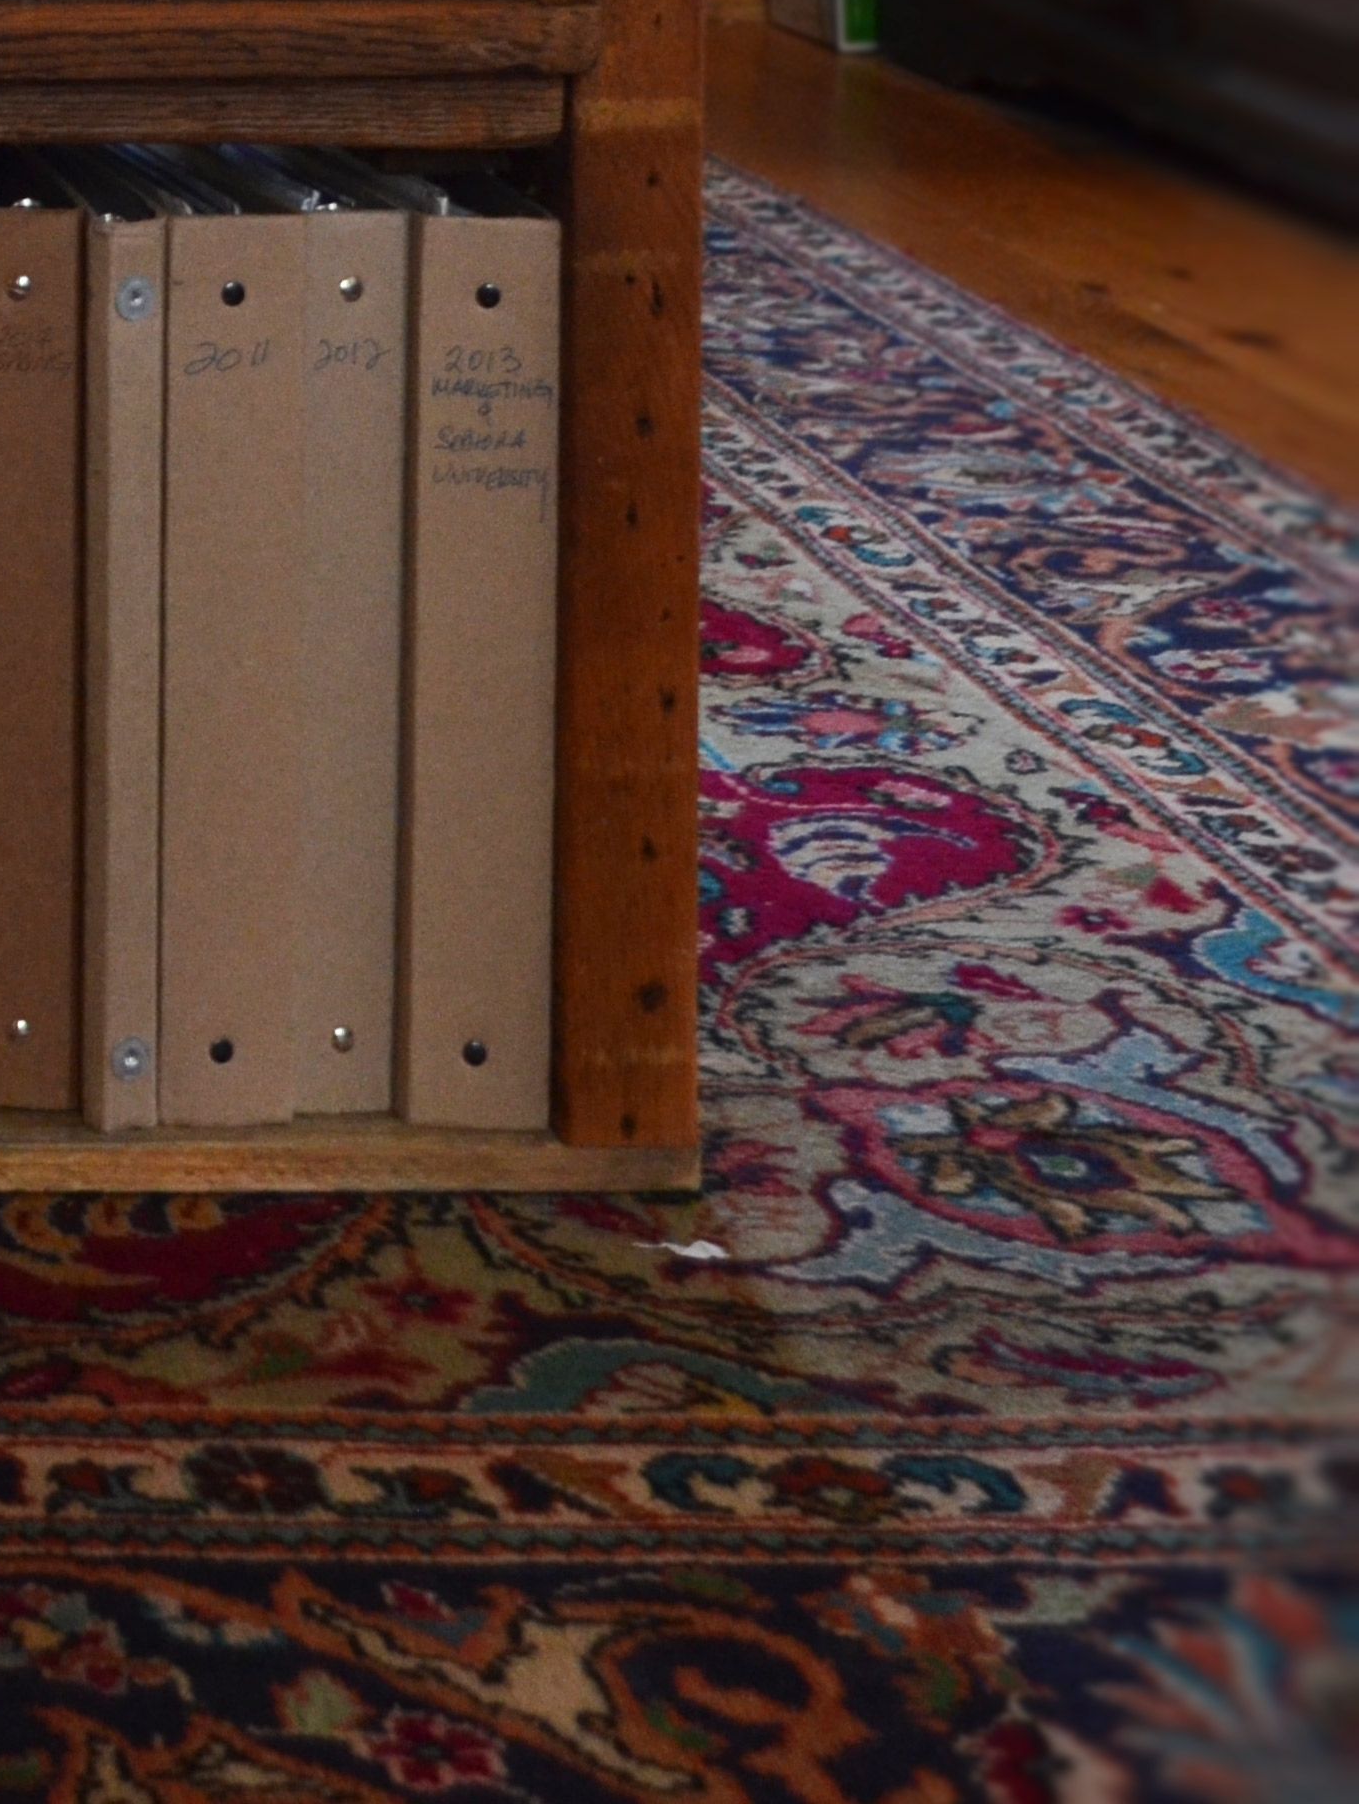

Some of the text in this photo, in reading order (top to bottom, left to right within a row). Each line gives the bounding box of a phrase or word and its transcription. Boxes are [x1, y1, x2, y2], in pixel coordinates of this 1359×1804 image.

[183, 338, 271, 376] 2011
[314, 338, 392, 372] 2012
[443, 345, 523, 374] 2013
